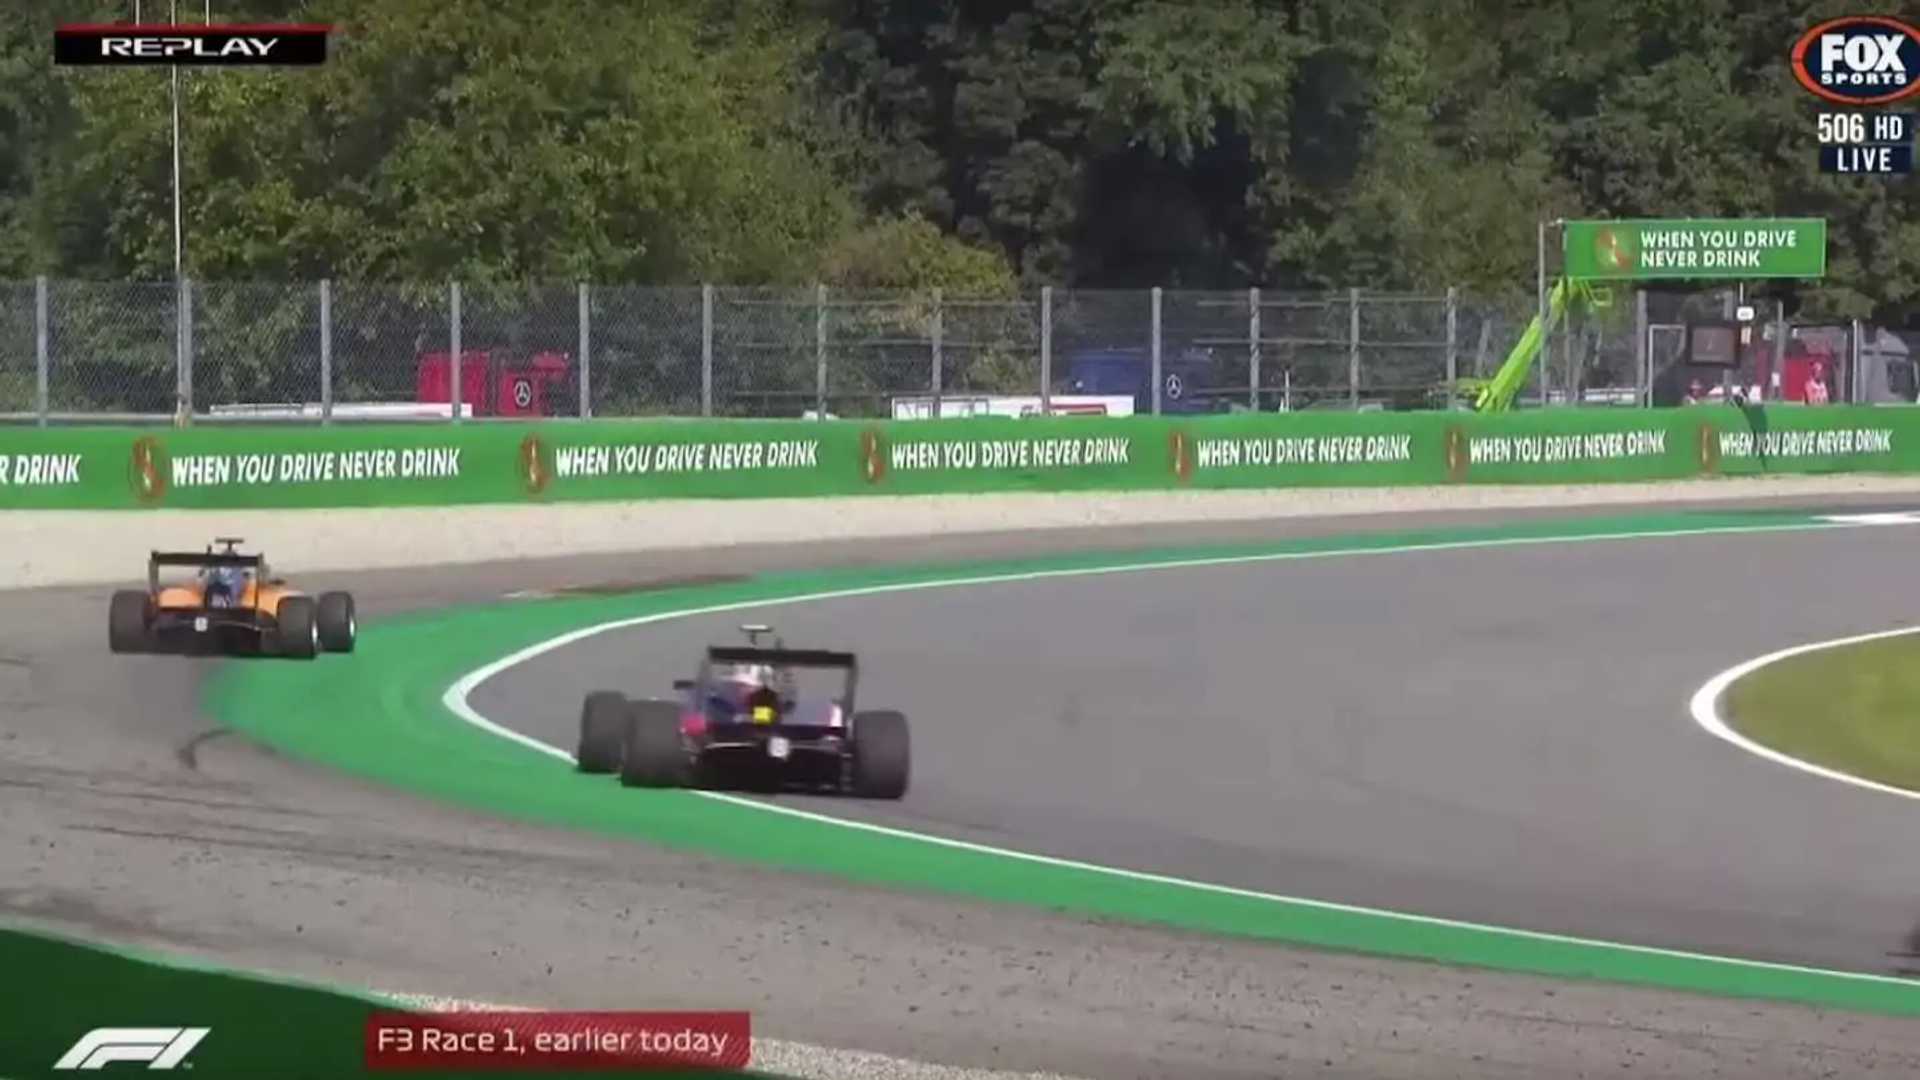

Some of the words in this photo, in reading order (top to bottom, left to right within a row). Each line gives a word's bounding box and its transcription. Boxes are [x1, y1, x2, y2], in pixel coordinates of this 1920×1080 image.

[1641, 231, 1694, 247] WHEN
[1700, 232, 1738, 247] YOU
[1744, 230, 1797, 247] DRIVE
[1641, 252, 1697, 267] NEVER
[1703, 250, 1760, 267] DRINK
[892, 442, 940, 469] WHEN
[943, 441, 977, 468] YOU
[980, 441, 1028, 467] DRIVE
[1033, 439, 1081, 465] NEVER
[1084, 438, 1130, 463] DRINK
[1197, 440, 1240, 467] WHEN
[1243, 439, 1272, 465] YOU
[1276, 437, 1315, 464] DRIVE
[1319, 436, 1362, 462] NEVER
[1366, 434, 1412, 460] DRINK
[1470, 437, 1511, 464] WHEN
[1514, 437, 1541, 462] YOU
[1545, 435, 1581, 461] DRIVE
[1585, 432, 1624, 457] NEVER
[1627, 429, 1666, 455] DRINK
[1719, 431, 1753, 456] WHEN
[1782, 430, 1816, 456] DRIVE
[1817, 430, 1853, 453] NEVER
[1856, 429, 1894, 451] DRINK
[14, 454, 81, 484] DRINK
[172, 456, 230, 486] WHEN
[236, 454, 276, 482] YOU
[280, 452, 335, 481] DRIVE
[339, 449, 397, 479] NEVER
[401, 448, 460, 476] DRINK
[556, 446, 610, 477] WHEN
[614, 445, 652, 473] YOU
[655, 443, 704, 471] DRIVE
[709, 442, 763, 470] NEVER
[767, 440, 818, 467] DRINK
